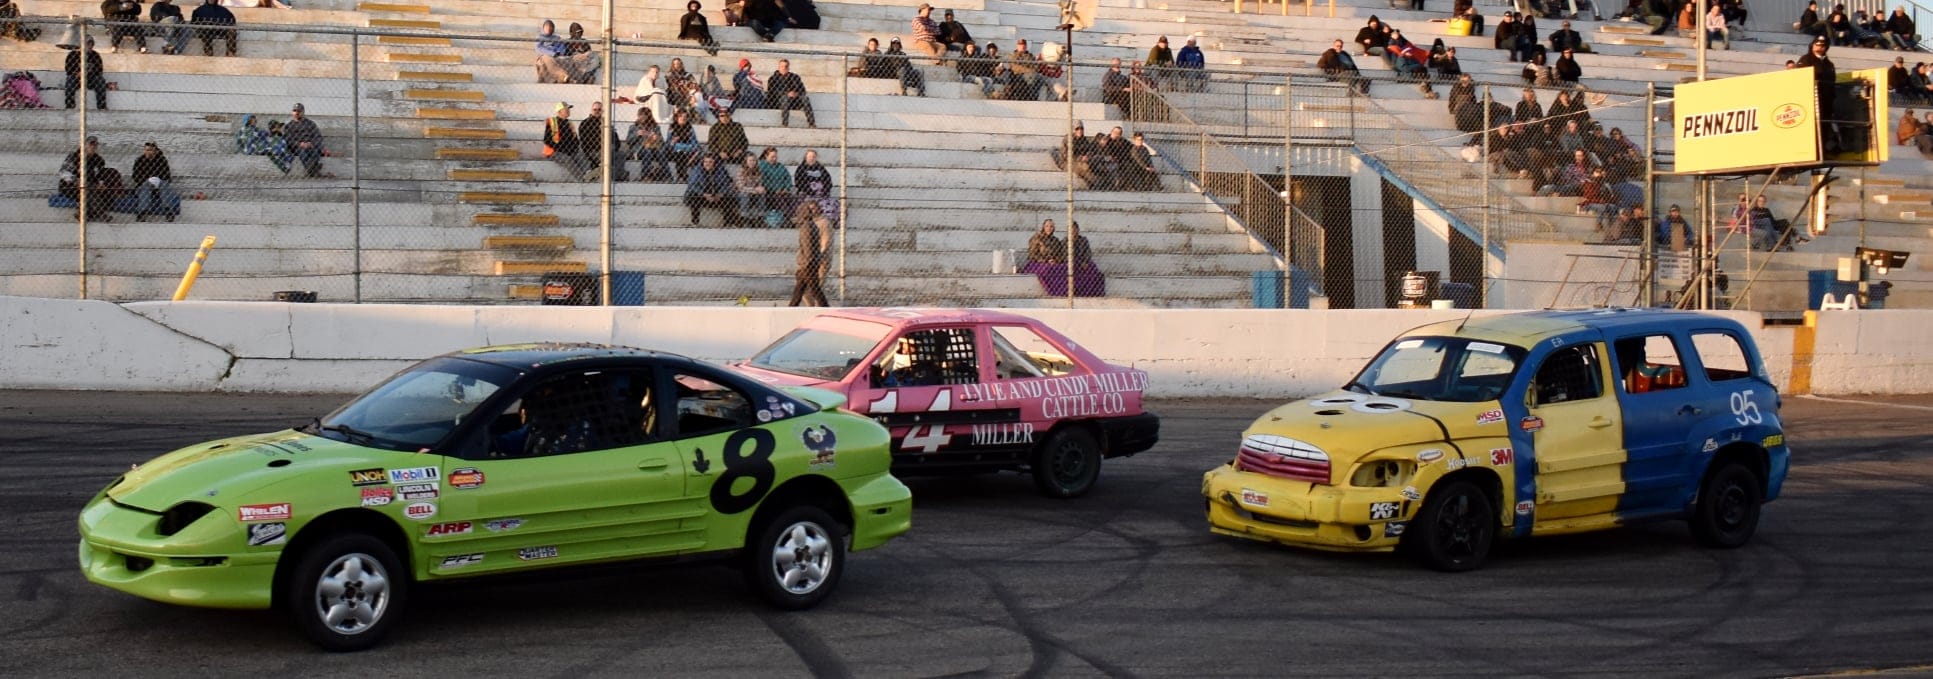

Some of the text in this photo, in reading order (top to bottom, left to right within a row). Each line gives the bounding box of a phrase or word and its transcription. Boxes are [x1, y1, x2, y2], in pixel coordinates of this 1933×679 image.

[1683, 109, 1758, 138] PENNZOIL
[961, 371, 1150, 403] LYLE AND CINDY MILLER
[1042, 392, 1126, 418] CATTLE CO.
[1730, 389, 1762, 426] 95
[1479, 410, 1502, 420] MSD
[971, 422, 1034, 445] MILLER
[1492, 449, 1513, 466] 3M
[352, 470, 385, 482] UNOH
[392, 469, 423, 481] Mobil
[710, 427, 776, 514] 8
[399, 484, 432, 493] LINCOLN
[361, 496, 391, 507] MSD
[408, 505, 433, 515] BELL
[429, 522, 472, 534] ARP
